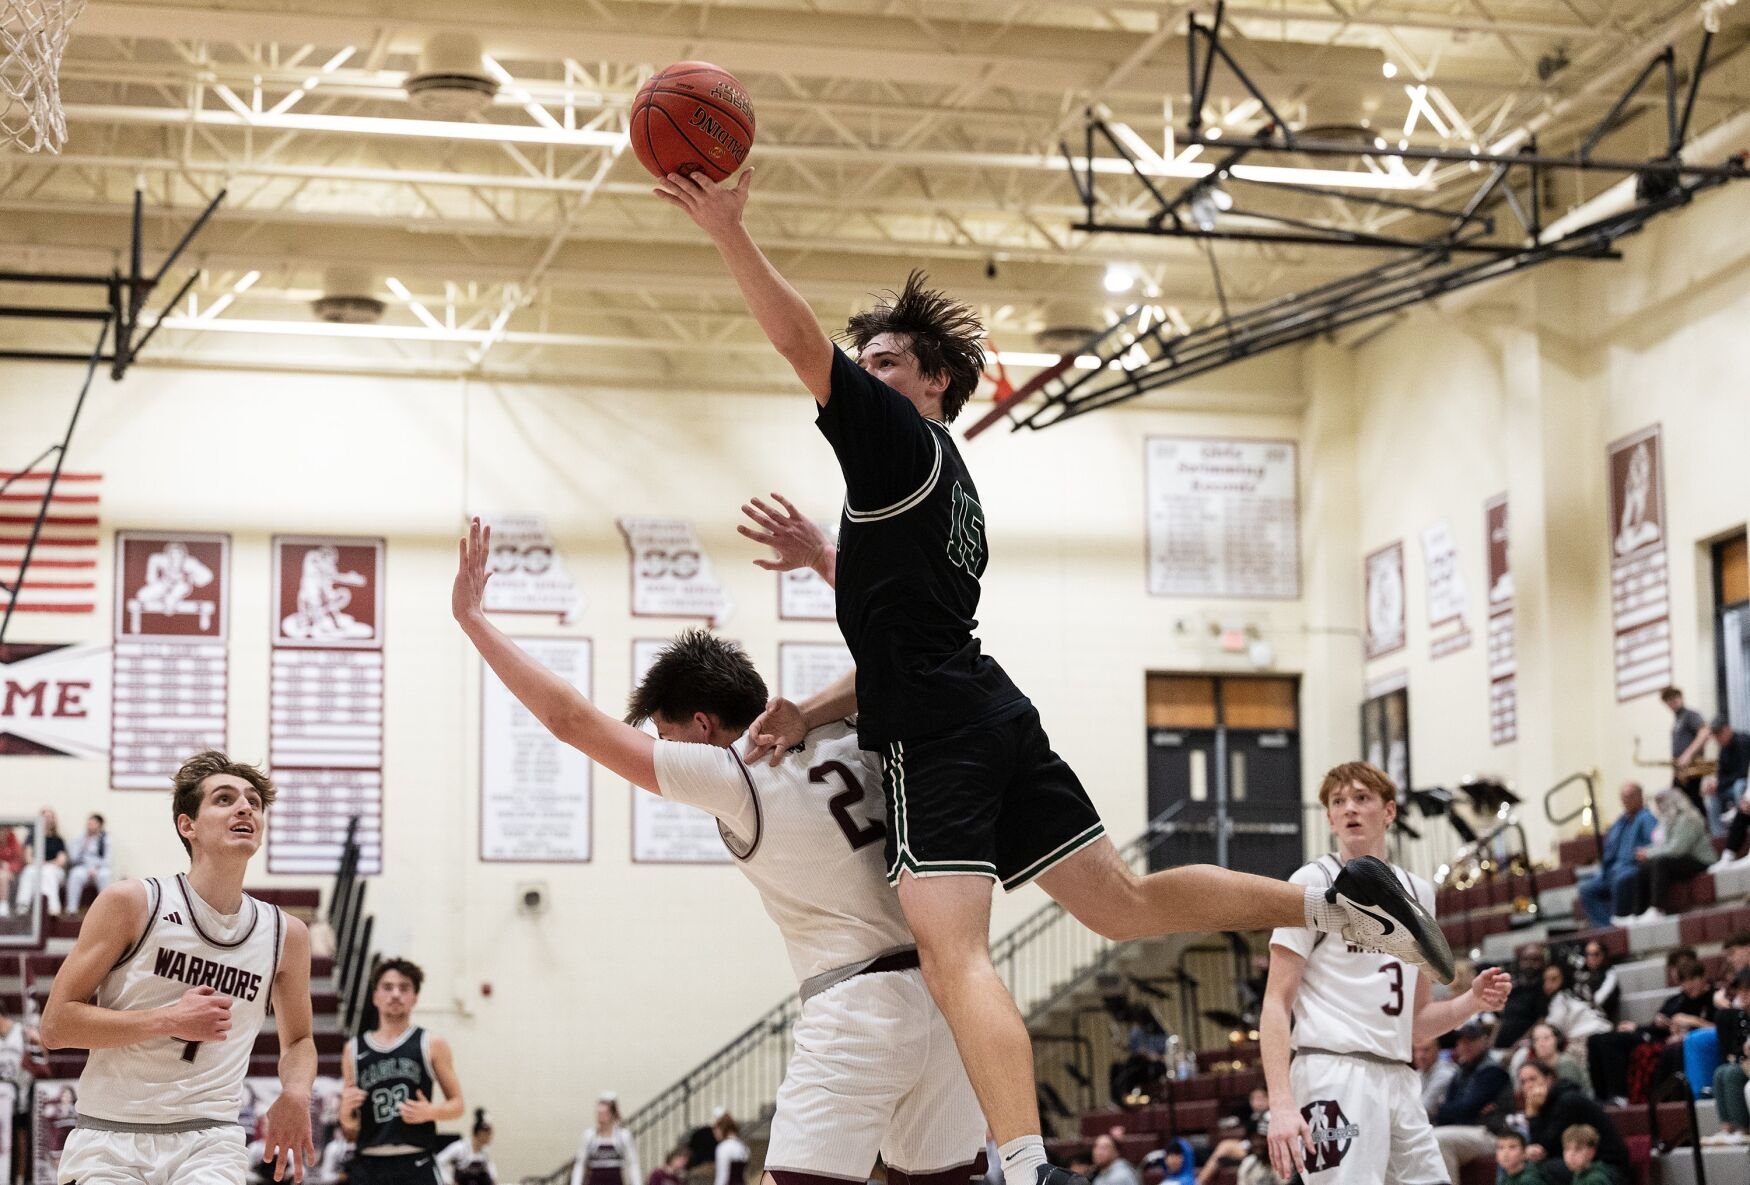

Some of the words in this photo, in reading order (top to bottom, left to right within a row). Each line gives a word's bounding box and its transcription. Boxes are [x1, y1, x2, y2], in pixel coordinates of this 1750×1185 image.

[688, 106, 750, 165] PALDING
[947, 480, 985, 581] 15
[1, 680, 91, 718] ME
[807, 760, 888, 852] 2
[153, 946, 263, 1002] WARRIORS
[1378, 961, 1404, 1017] 3
